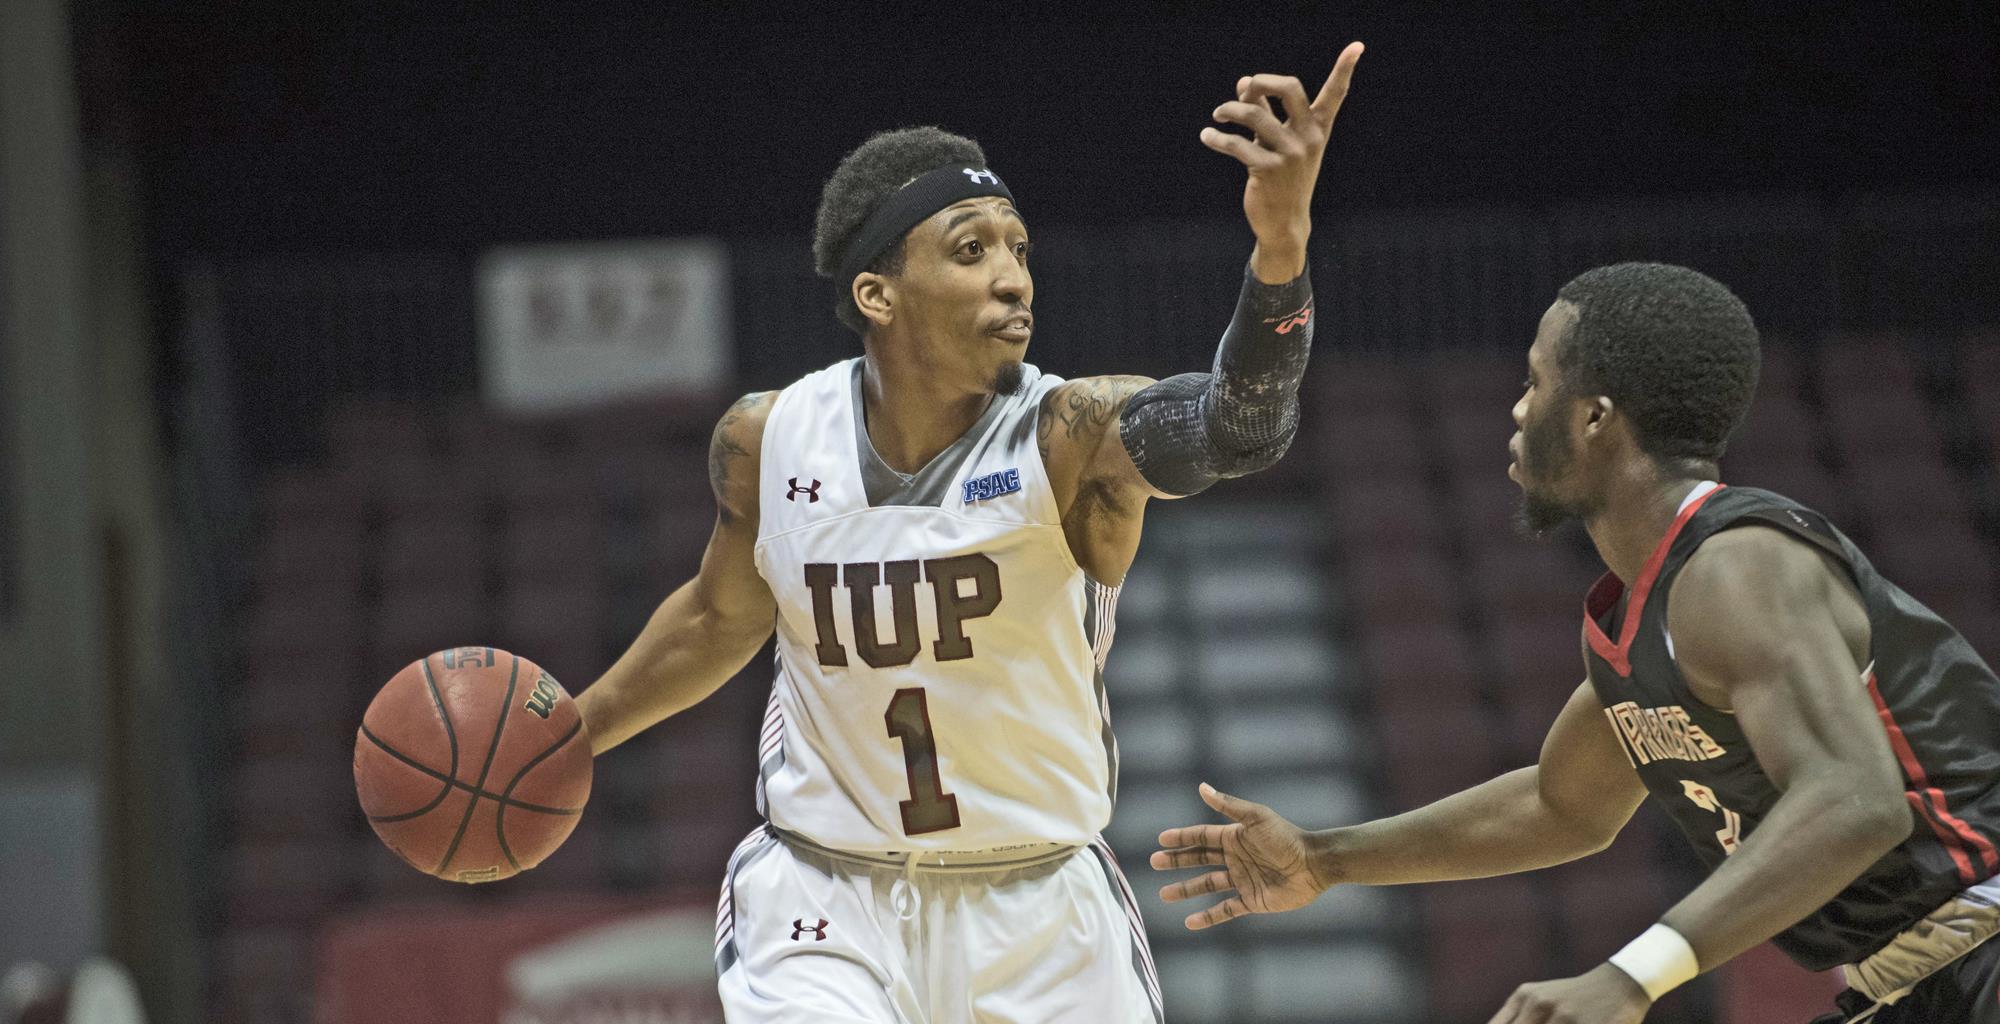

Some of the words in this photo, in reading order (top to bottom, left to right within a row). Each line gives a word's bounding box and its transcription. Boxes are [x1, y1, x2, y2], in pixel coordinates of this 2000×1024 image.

[963, 467, 1021, 505] PSAC
[804, 552, 1002, 669] IUP
[884, 687, 961, 836] 1
[1603, 701, 1727, 769] ARRIORS
